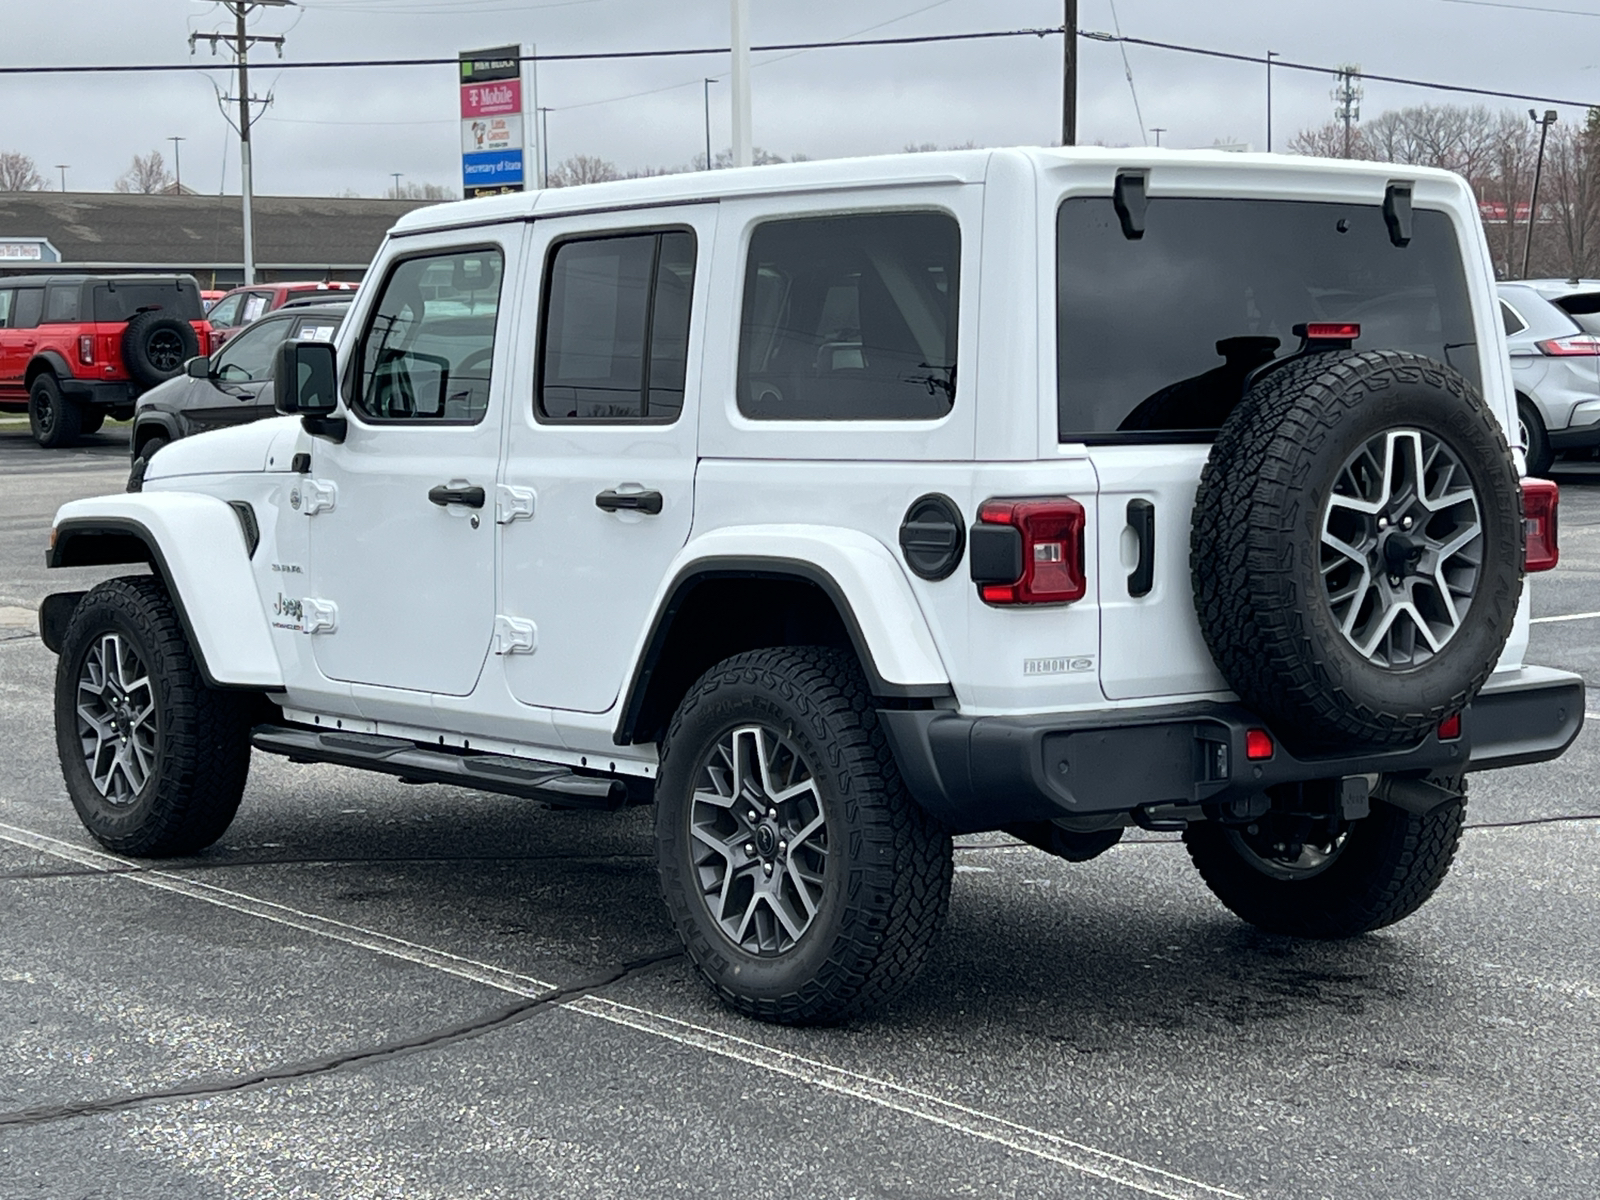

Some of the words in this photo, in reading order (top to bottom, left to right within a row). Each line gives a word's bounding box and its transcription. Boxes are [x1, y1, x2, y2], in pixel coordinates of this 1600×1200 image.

[480, 86, 513, 105] Mobile
[465, 164, 495, 175] Secretary
[496, 161, 504, 171] of
[504, 161, 522, 170] State
[273, 592, 303, 622] Jeep
[1023, 659, 1071, 673] FREMONT
